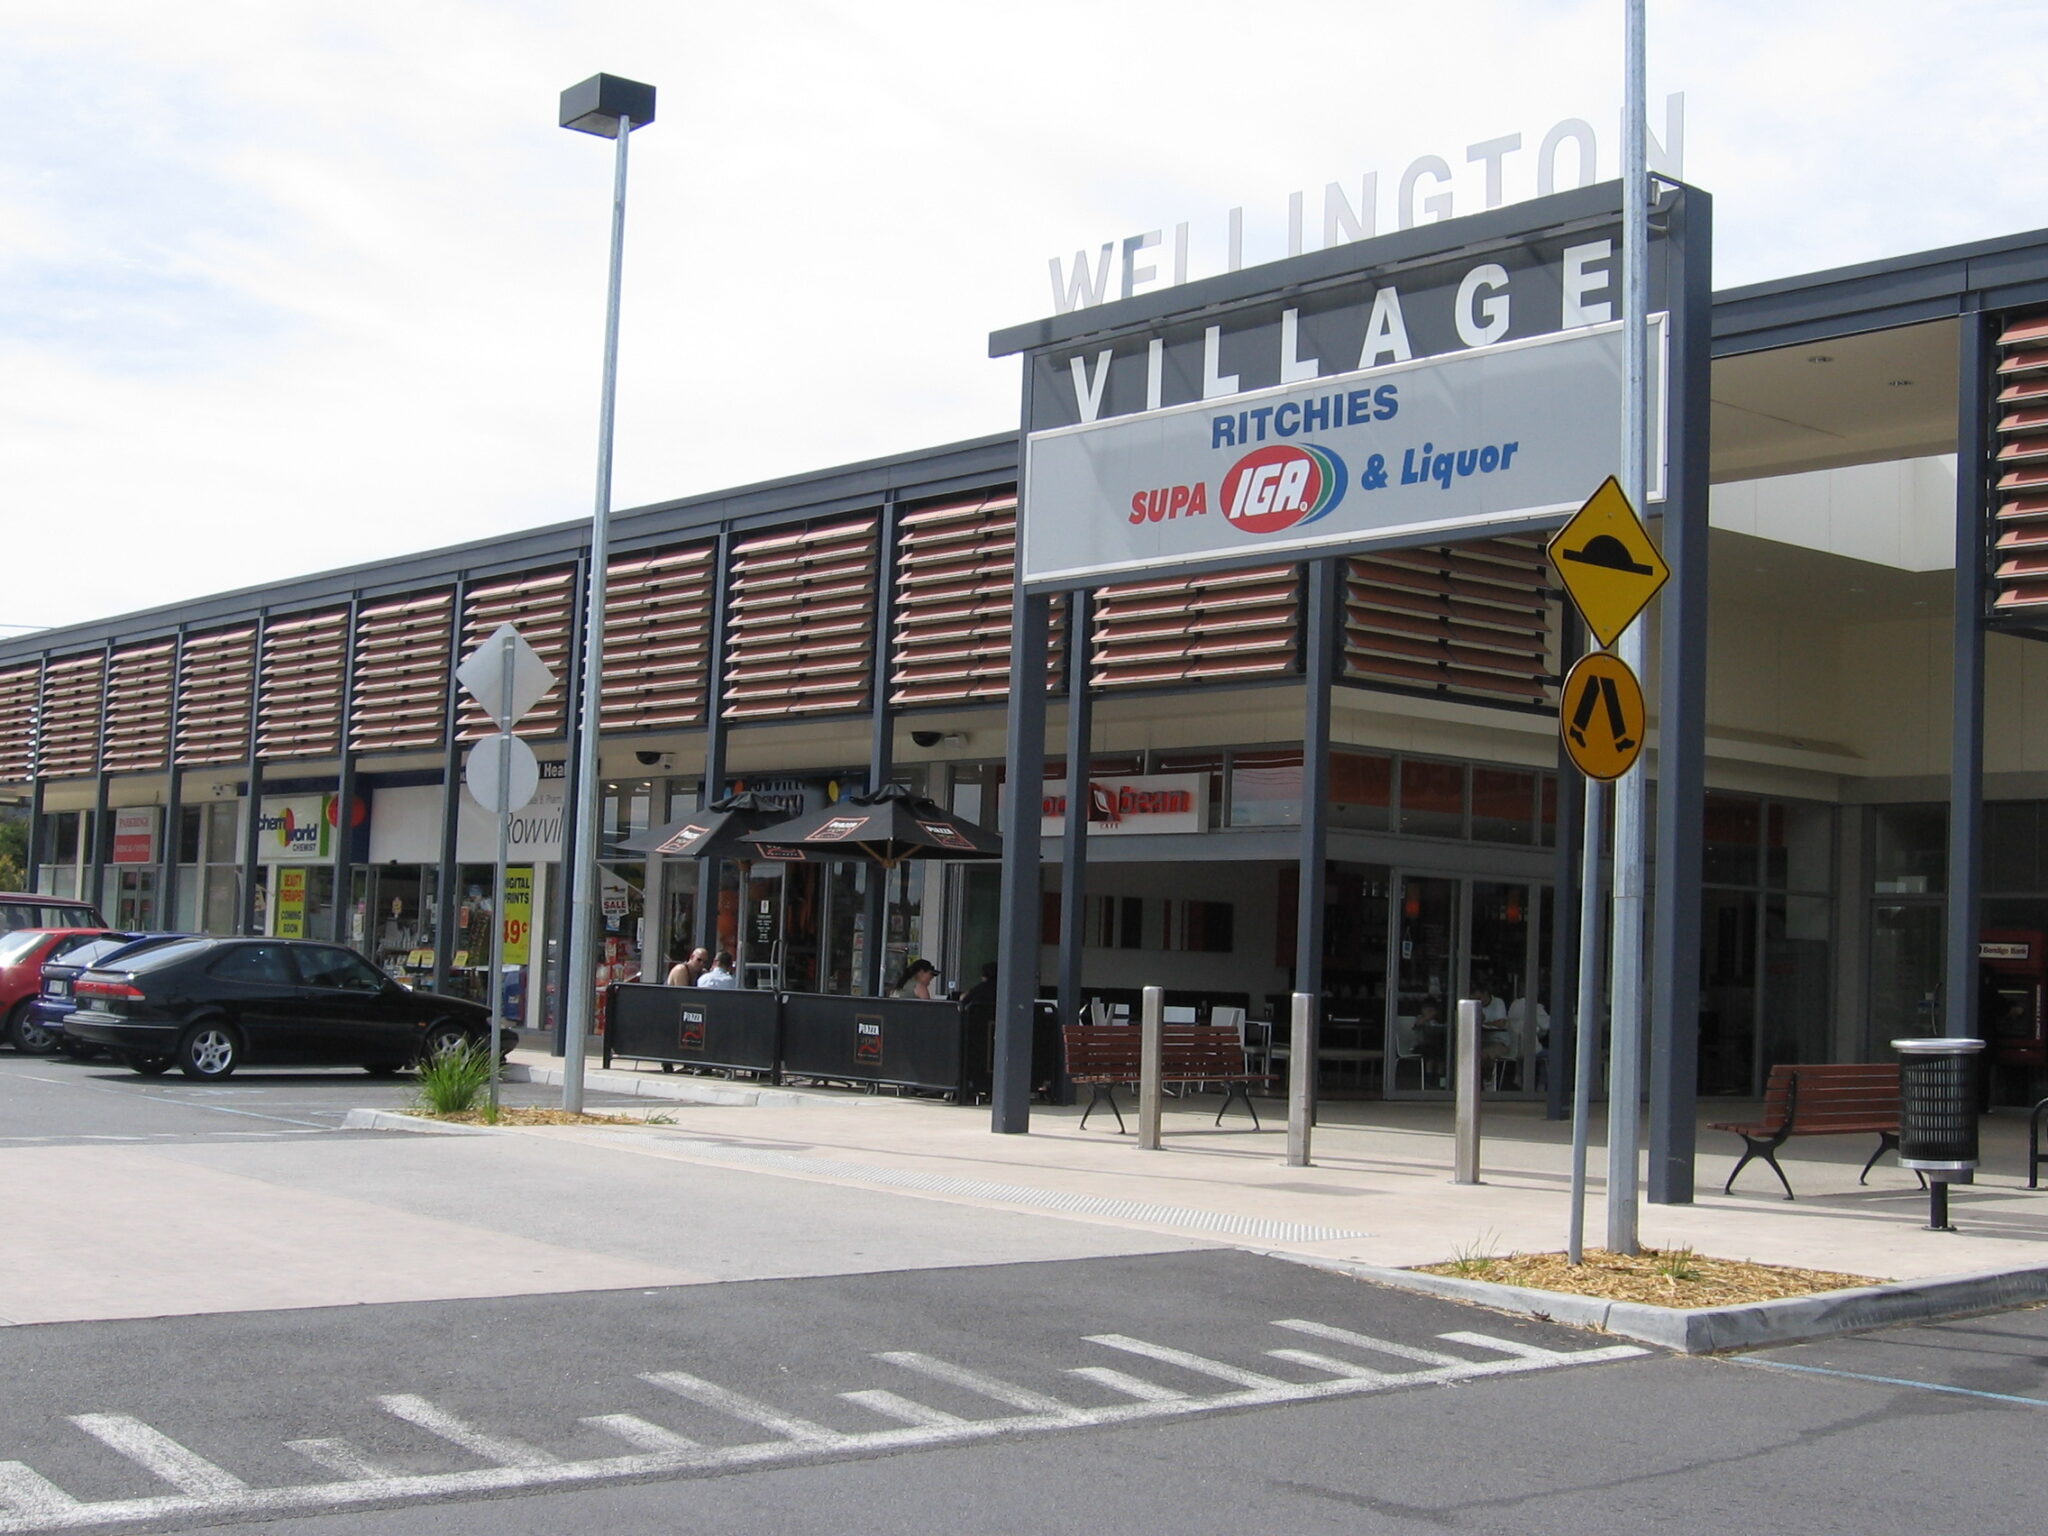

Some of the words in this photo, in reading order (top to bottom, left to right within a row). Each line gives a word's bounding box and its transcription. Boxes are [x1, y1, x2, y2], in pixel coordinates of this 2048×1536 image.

[1070, 238, 1612, 421] VILLAGE
[1211, 384, 1399, 450] RITCHIES
[1128, 481, 1208, 525] SUPA
[1228, 459, 1311, 520] IGA
[1360, 453, 1389, 491] &
[1400, 441, 1520, 490] Liquor
[1119, 785, 1191, 814] bean
[292, 843, 317, 852] CHEMIST
[603, 901, 627, 910] SALE
[283, 923, 298, 933] SOON
[1983, 946, 2009, 955] Bendigo
